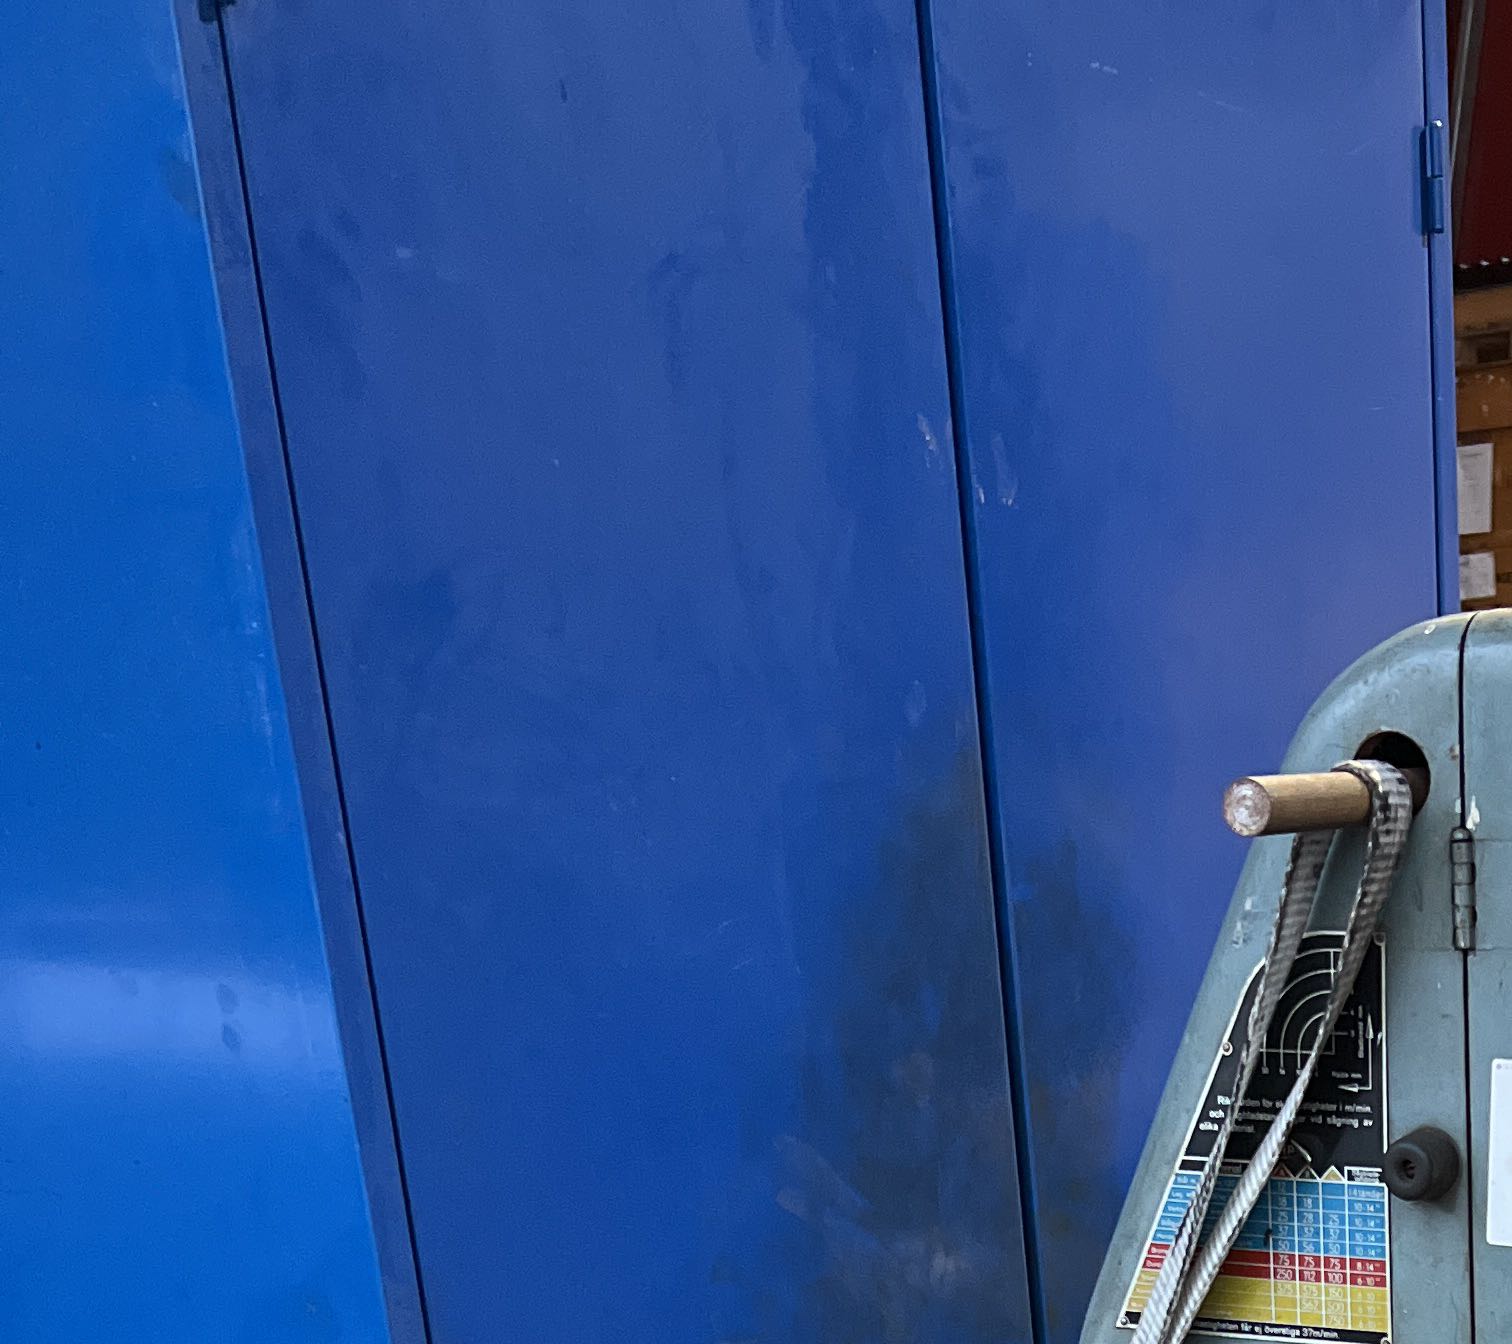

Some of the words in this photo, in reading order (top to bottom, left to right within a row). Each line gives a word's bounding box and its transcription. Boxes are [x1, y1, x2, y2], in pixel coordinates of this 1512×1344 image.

[1363, 1119, 1374, 1127] av
[1280, 1255, 1290, 1266] 75
[1304, 1256, 1315, 1268] 75
[1329, 1258, 1340, 1270] 75
[1277, 1269, 1292, 1280] 250
[1303, 1271, 1316, 1282] 112
[1328, 1272, 1344, 1284] 100
[1329, 1287, 1344, 1298] 150
